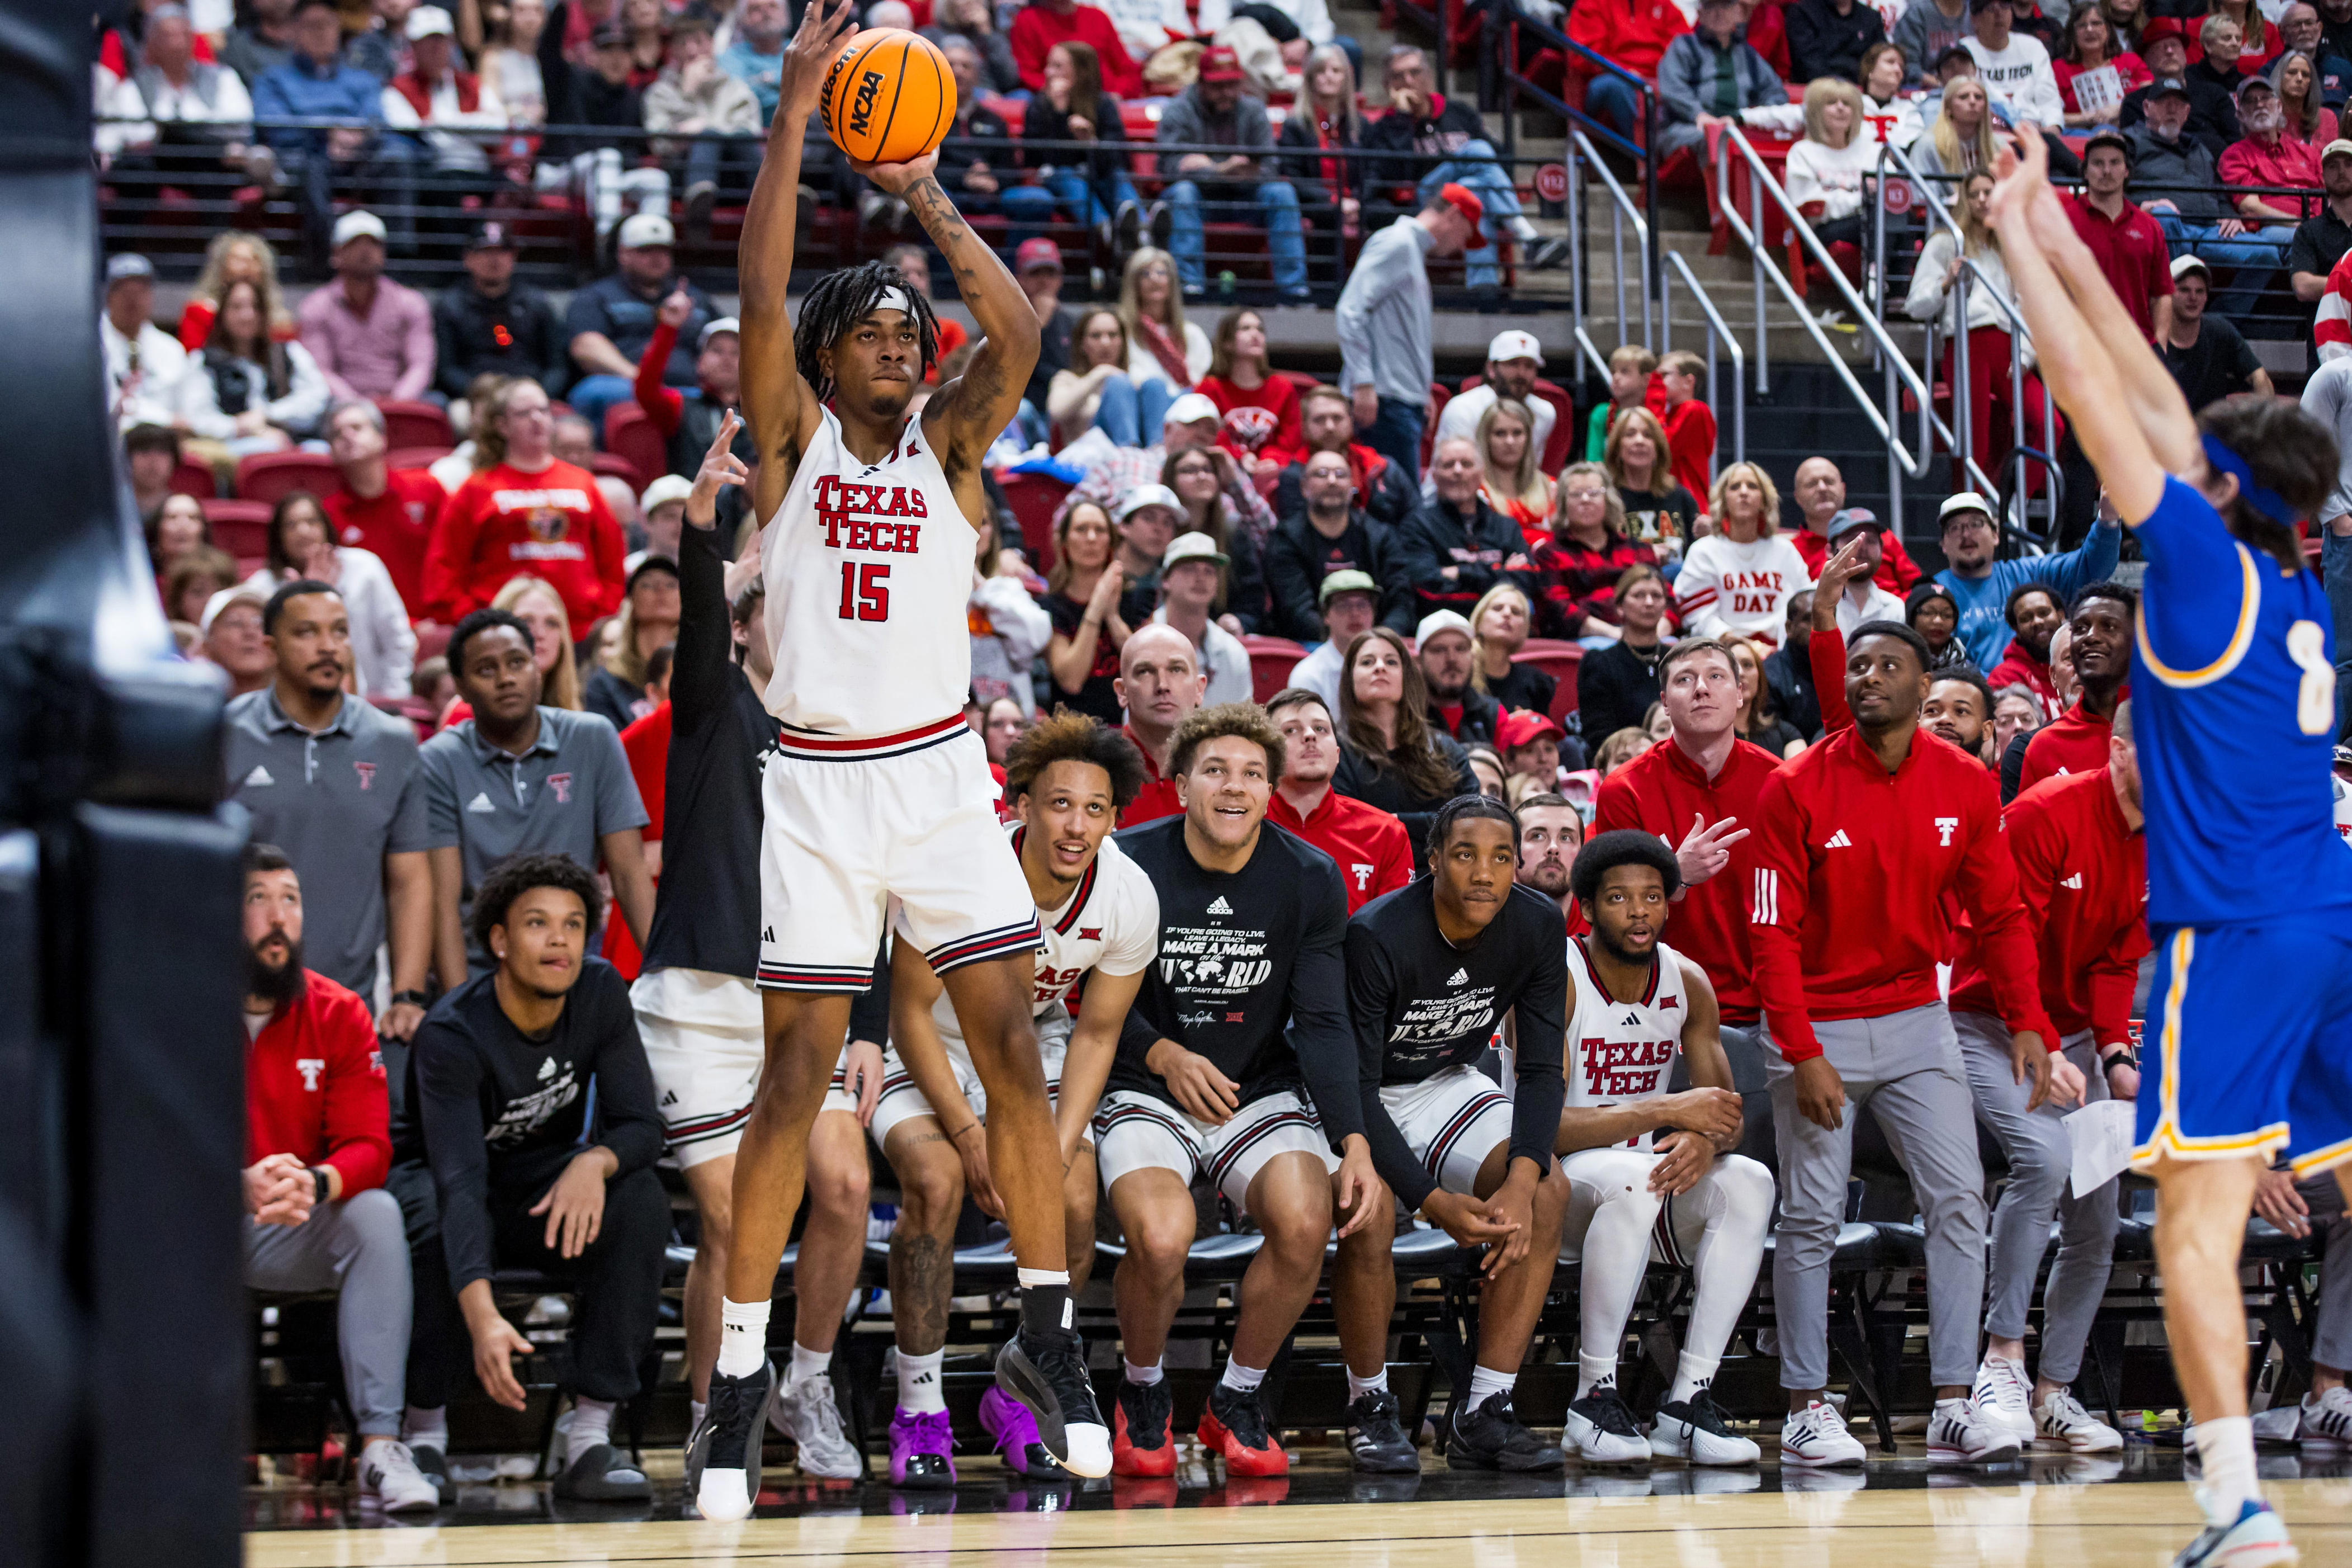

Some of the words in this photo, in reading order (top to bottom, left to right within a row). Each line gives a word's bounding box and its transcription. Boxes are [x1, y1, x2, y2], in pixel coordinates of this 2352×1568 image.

[820, 46, 860, 132] Wilson
[849, 70, 885, 137] NCAA
[813, 475, 928, 518] TEXAS
[819, 509, 921, 554] TECH
[839, 561, 891, 622] 15
[1723, 570, 1783, 592] GAME
[1734, 594, 1777, 612] DAY
[1162, 941, 1206, 953] MAKE
[1206, 942, 1218, 954] A
[1221, 943, 1267, 956] MARK
[1402, 1010, 1446, 1021] MAKE
[1443, 1007, 1454, 1018] A
[1456, 996, 1495, 1015] MARK
[1447, 993, 1468, 1004] GOING
[1580, 1037, 1674, 1067] TEXAS
[1585, 1066, 1661, 1095] TECH
